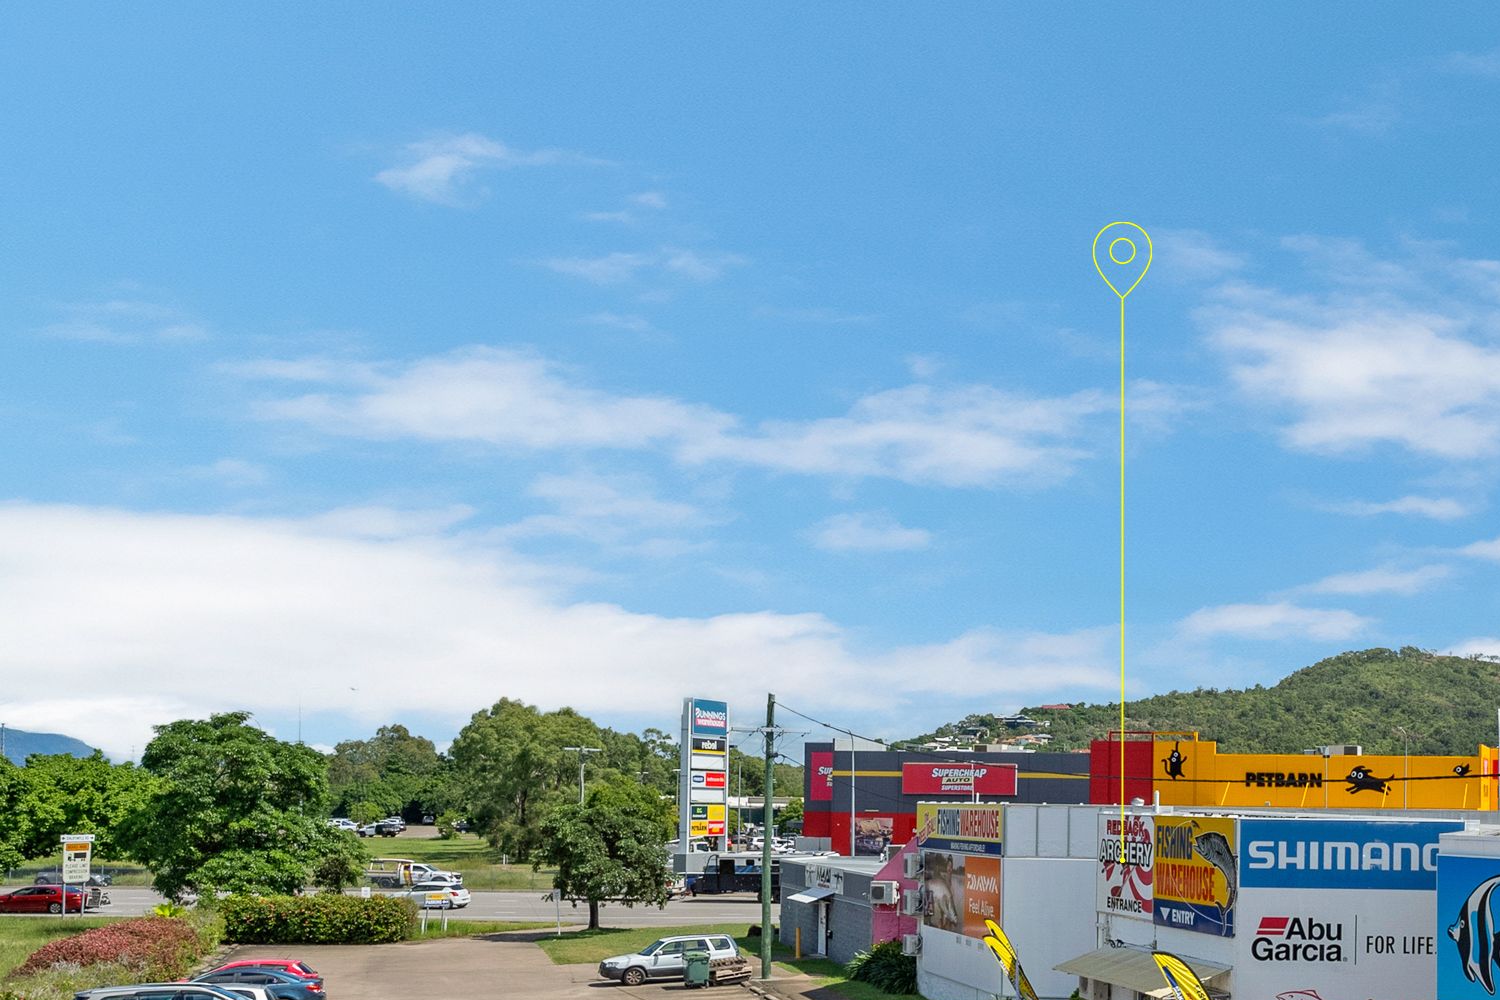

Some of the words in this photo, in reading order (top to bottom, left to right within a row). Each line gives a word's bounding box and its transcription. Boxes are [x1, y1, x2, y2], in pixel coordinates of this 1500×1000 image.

[931, 767, 987, 778] SUPERCHEAP
[1245, 772, 1322, 788] PETBARN
[937, 809, 960, 835] FISHING
[960, 809, 1000, 838] WAREHOUSE
[1107, 819, 1146, 837] REDBACK
[1156, 825, 1193, 860] FISHING
[1099, 838, 1153, 867] ARCHERY
[1156, 862, 1215, 902] WAREHOUSE
[969, 898, 980, 914] Feel
[1107, 896, 1142, 913] ENTRANCE
[1171, 909, 1195, 925] ENTRY
[1285, 917, 1343, 941] Abu
[1251, 937, 1342, 962] Garcia
[1366, 935, 1396, 954] FOR
